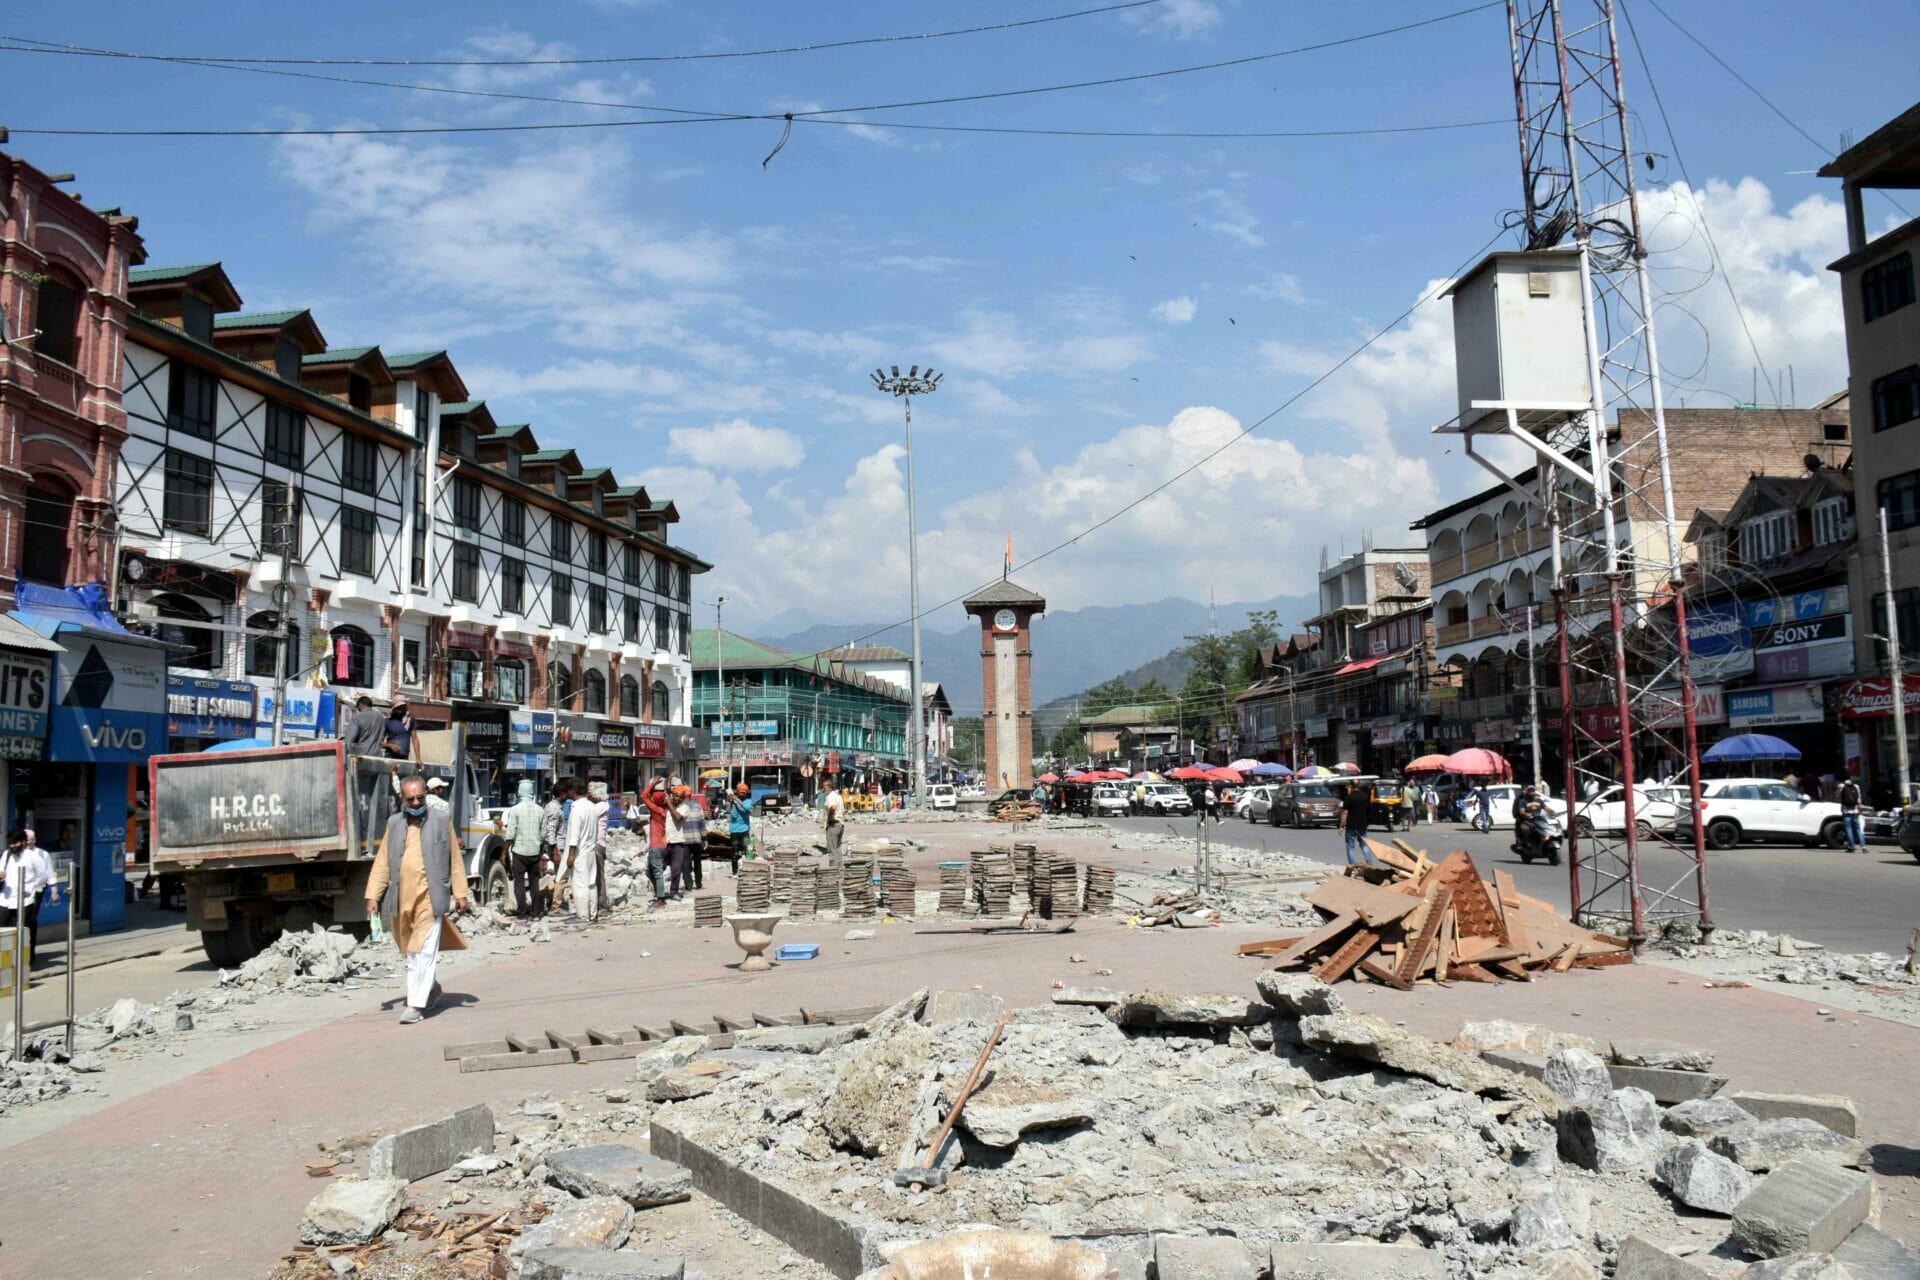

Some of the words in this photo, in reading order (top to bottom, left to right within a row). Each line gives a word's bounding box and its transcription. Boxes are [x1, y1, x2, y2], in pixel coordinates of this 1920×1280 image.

[1774, 624, 1822, 644] SONY
[1782, 656, 1800, 673] LG
[263, 697, 313, 717] PILIPS
[1732, 695, 1770, 710] SAMSUNG
[0, 711, 40, 731] NEY
[467, 722, 503, 736] AMSUNG
[82, 719, 146, 750] vivo
[96, 827, 125, 837] vivo
